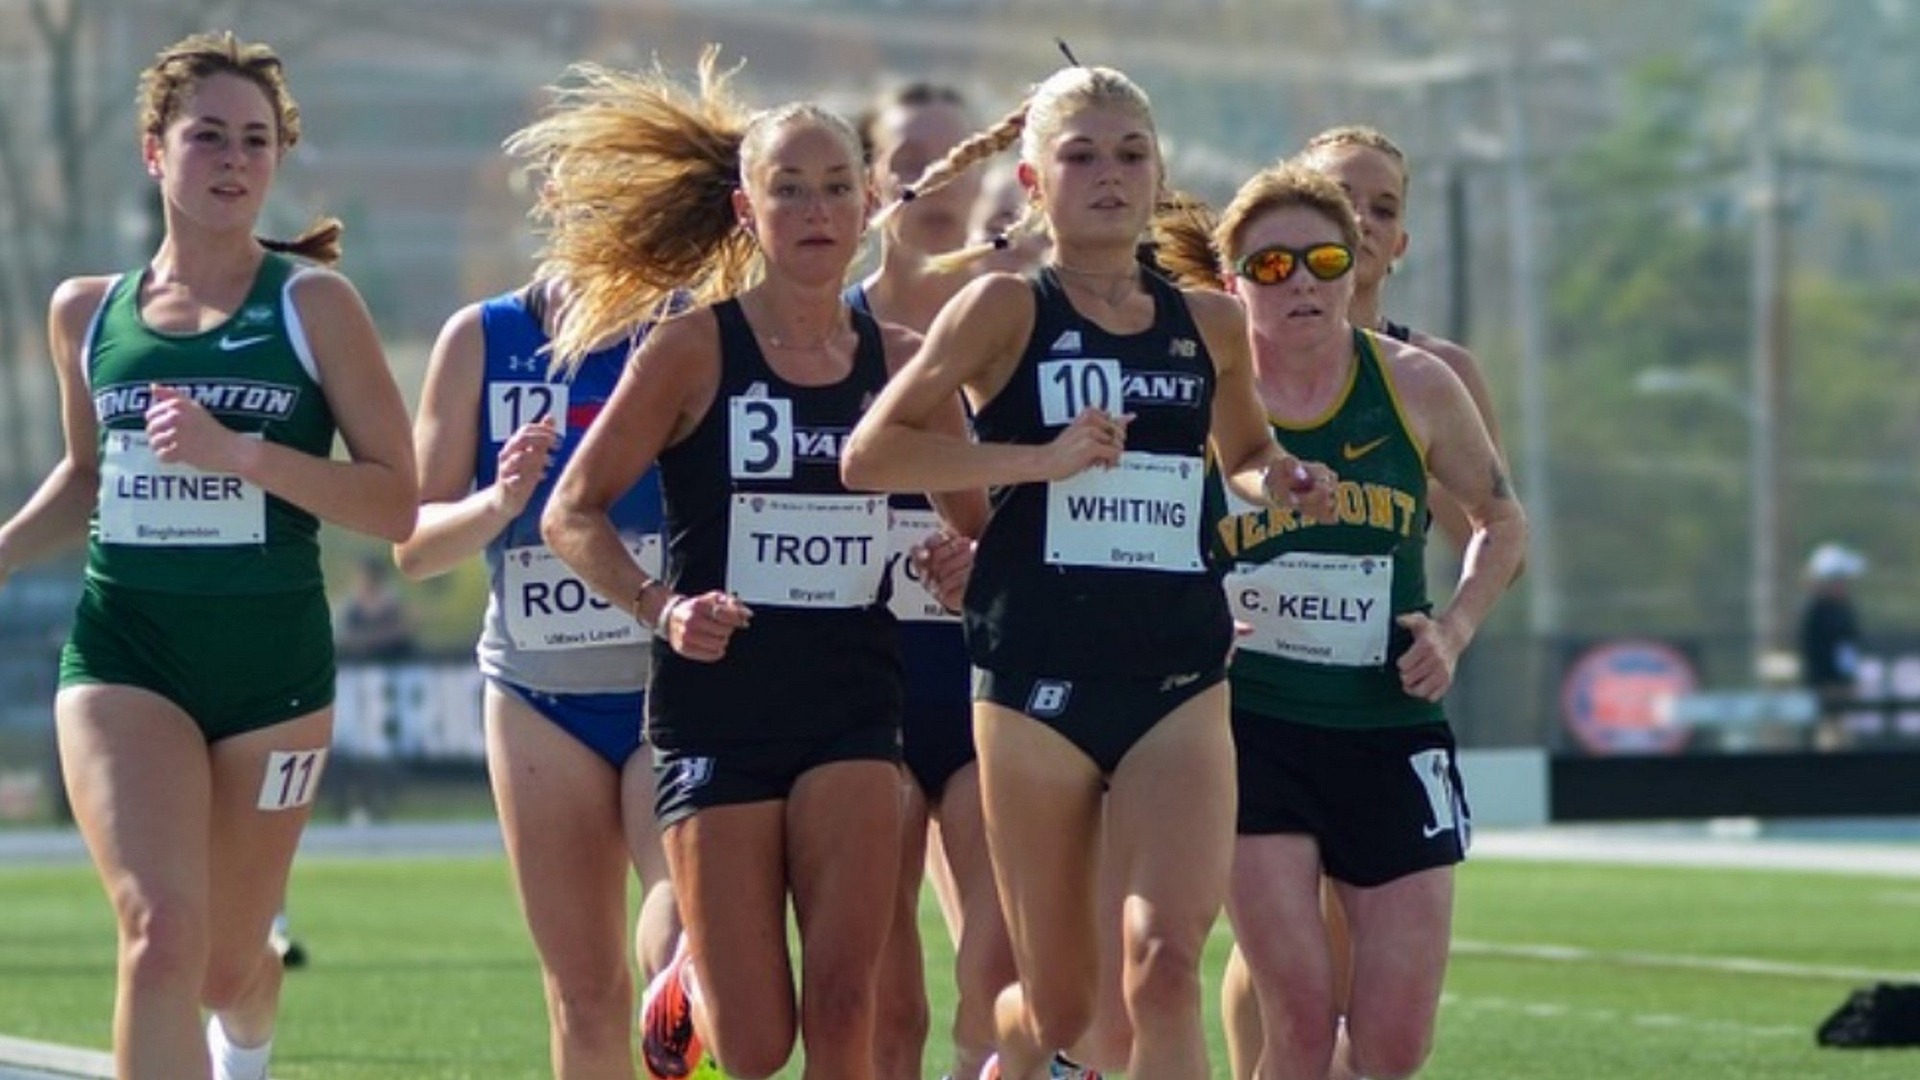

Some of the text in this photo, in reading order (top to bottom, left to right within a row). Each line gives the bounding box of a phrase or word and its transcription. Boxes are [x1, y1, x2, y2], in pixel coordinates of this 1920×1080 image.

[1053, 363, 1110, 419] 10
[502, 386, 556, 436] 12
[742, 400, 780, 473] 3
[116, 474, 243, 501] LEITNER
[1067, 495, 1187, 529] WHITING
[1218, 480, 1417, 557] VERONT
[136, 523, 220, 541] Binghamton
[750, 532, 873, 567] TROTT
[1111, 548, 1155, 564] Bryant
[788, 586, 837, 602] Bryant
[1240, 588, 1374, 622] C. KELLY
[1276, 639, 1334, 658] Vermont
[279, 753, 317, 806] 11
